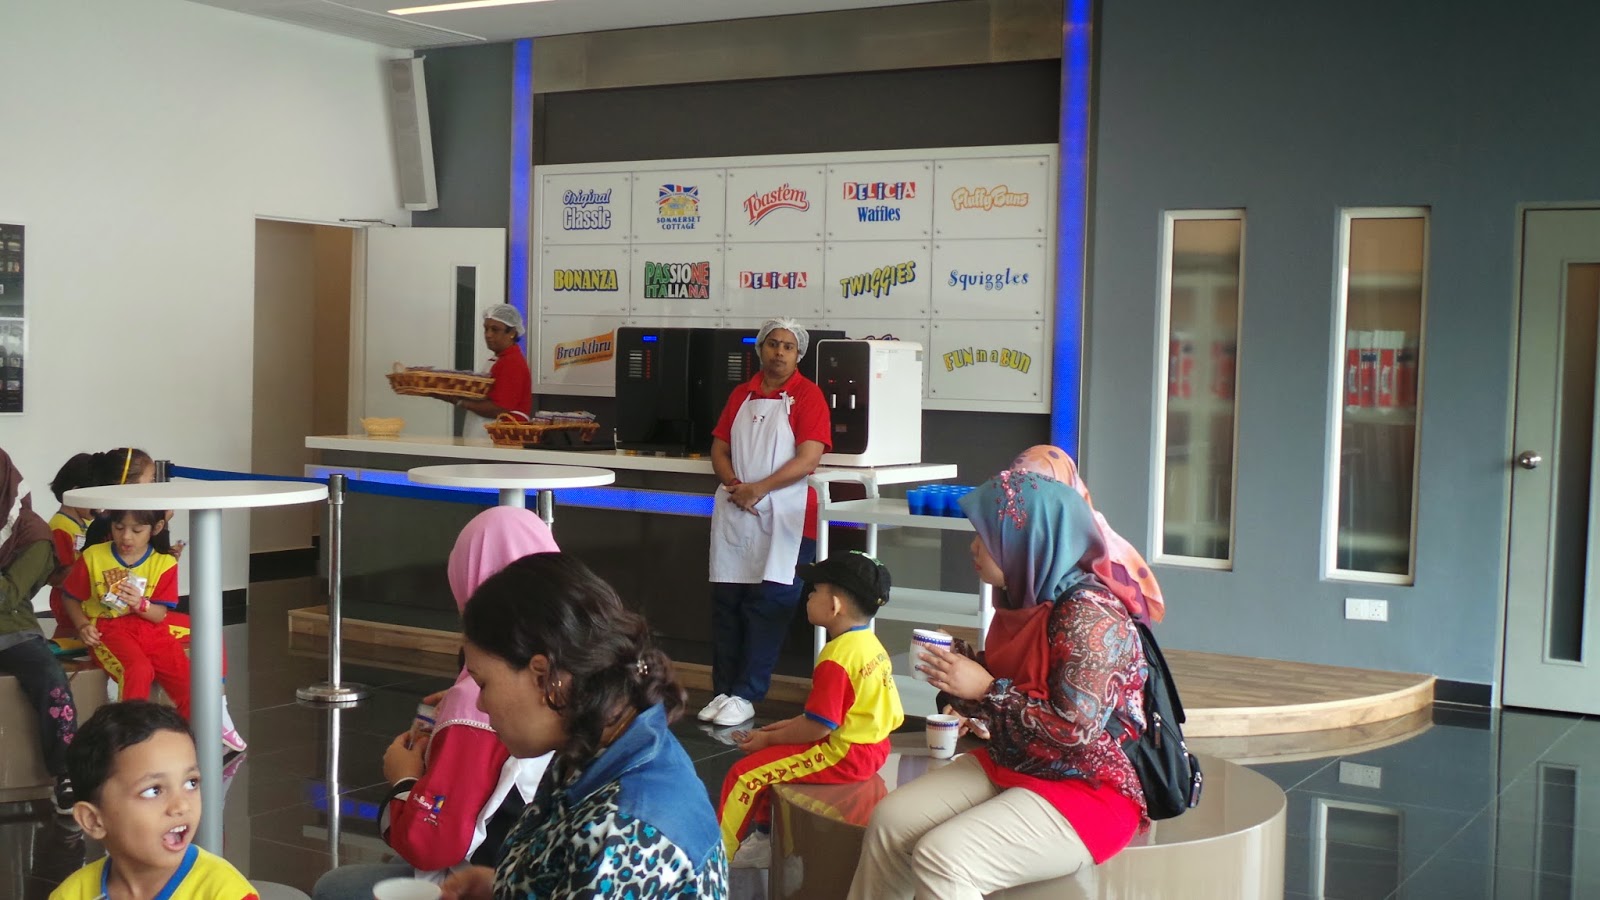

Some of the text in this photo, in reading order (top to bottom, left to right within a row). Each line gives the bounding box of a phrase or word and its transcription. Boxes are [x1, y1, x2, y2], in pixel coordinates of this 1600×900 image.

[563, 188, 612, 208] Original
[952, 184, 1028, 211] Fluffy Buns
[563, 206, 612, 230] Classic
[857, 205, 901, 222] Waffles
[554, 269, 618, 291] BONANZA
[645, 261, 710, 286] PASSIONE
[840, 260, 916, 298] TWIGGIES
[948, 267, 1029, 290] Squiggles
[645, 283, 710, 299] ITALIANA
[556, 339, 611, 360] Breakthru
[943, 347, 974, 372] FUN
[976, 349, 988, 362] in
[989, 350, 999, 363] a
